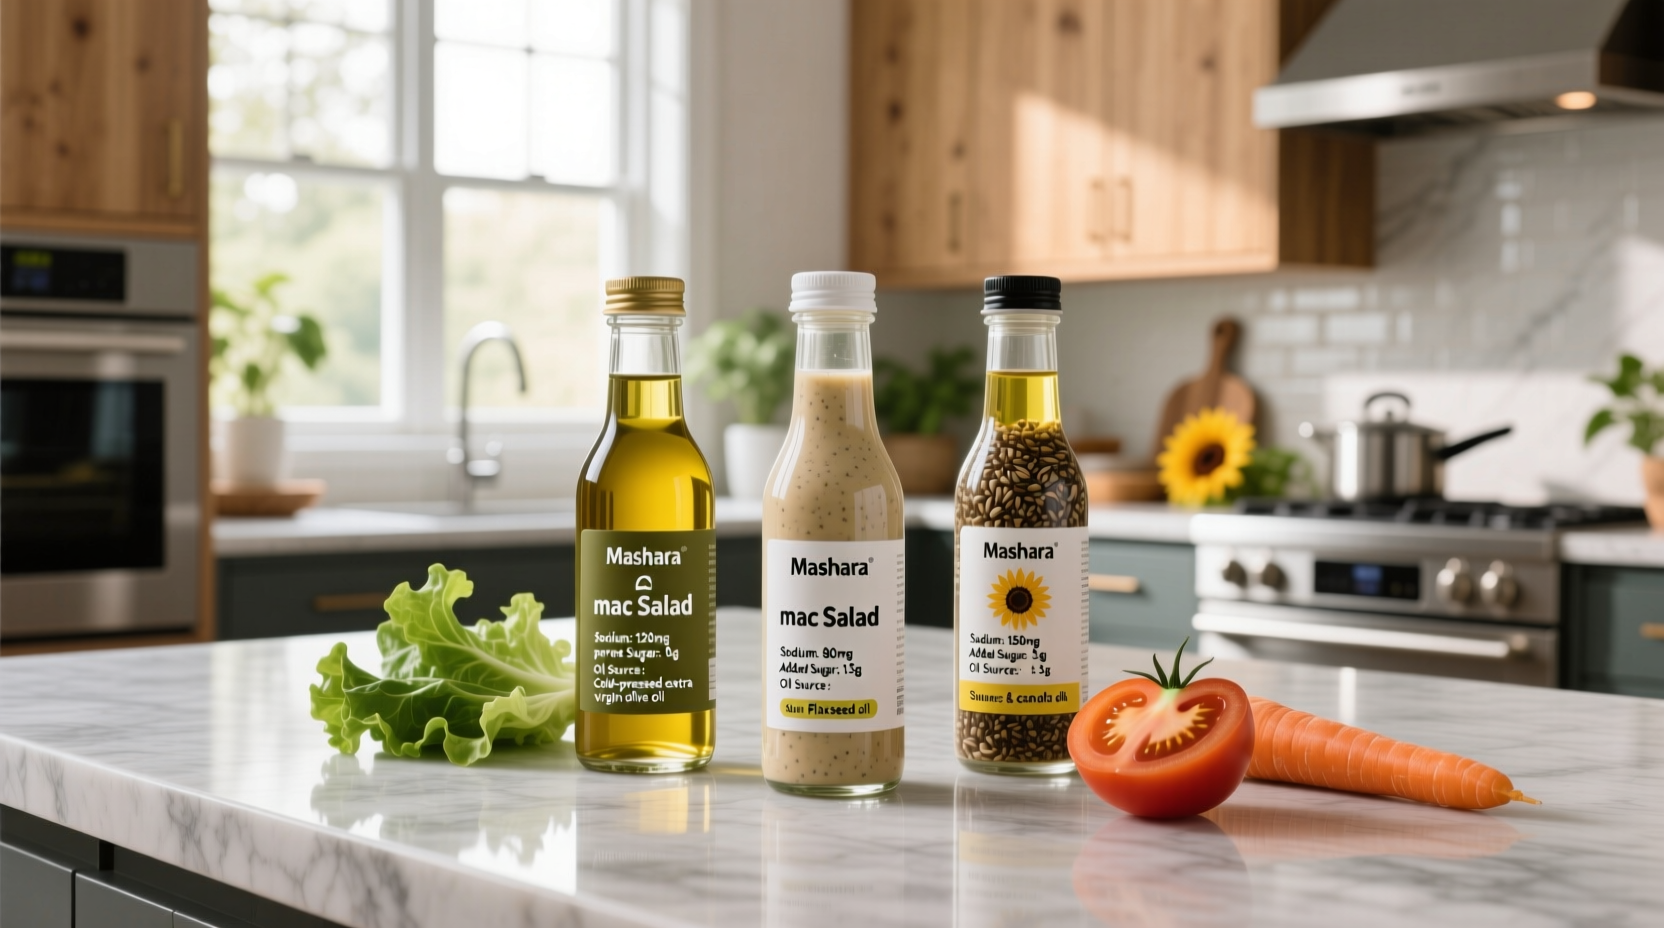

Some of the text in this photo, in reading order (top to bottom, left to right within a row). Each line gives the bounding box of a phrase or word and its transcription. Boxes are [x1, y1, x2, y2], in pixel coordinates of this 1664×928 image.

[594, 593, 693, 616] mac Salad
[780, 605, 879, 627] mac Salad
